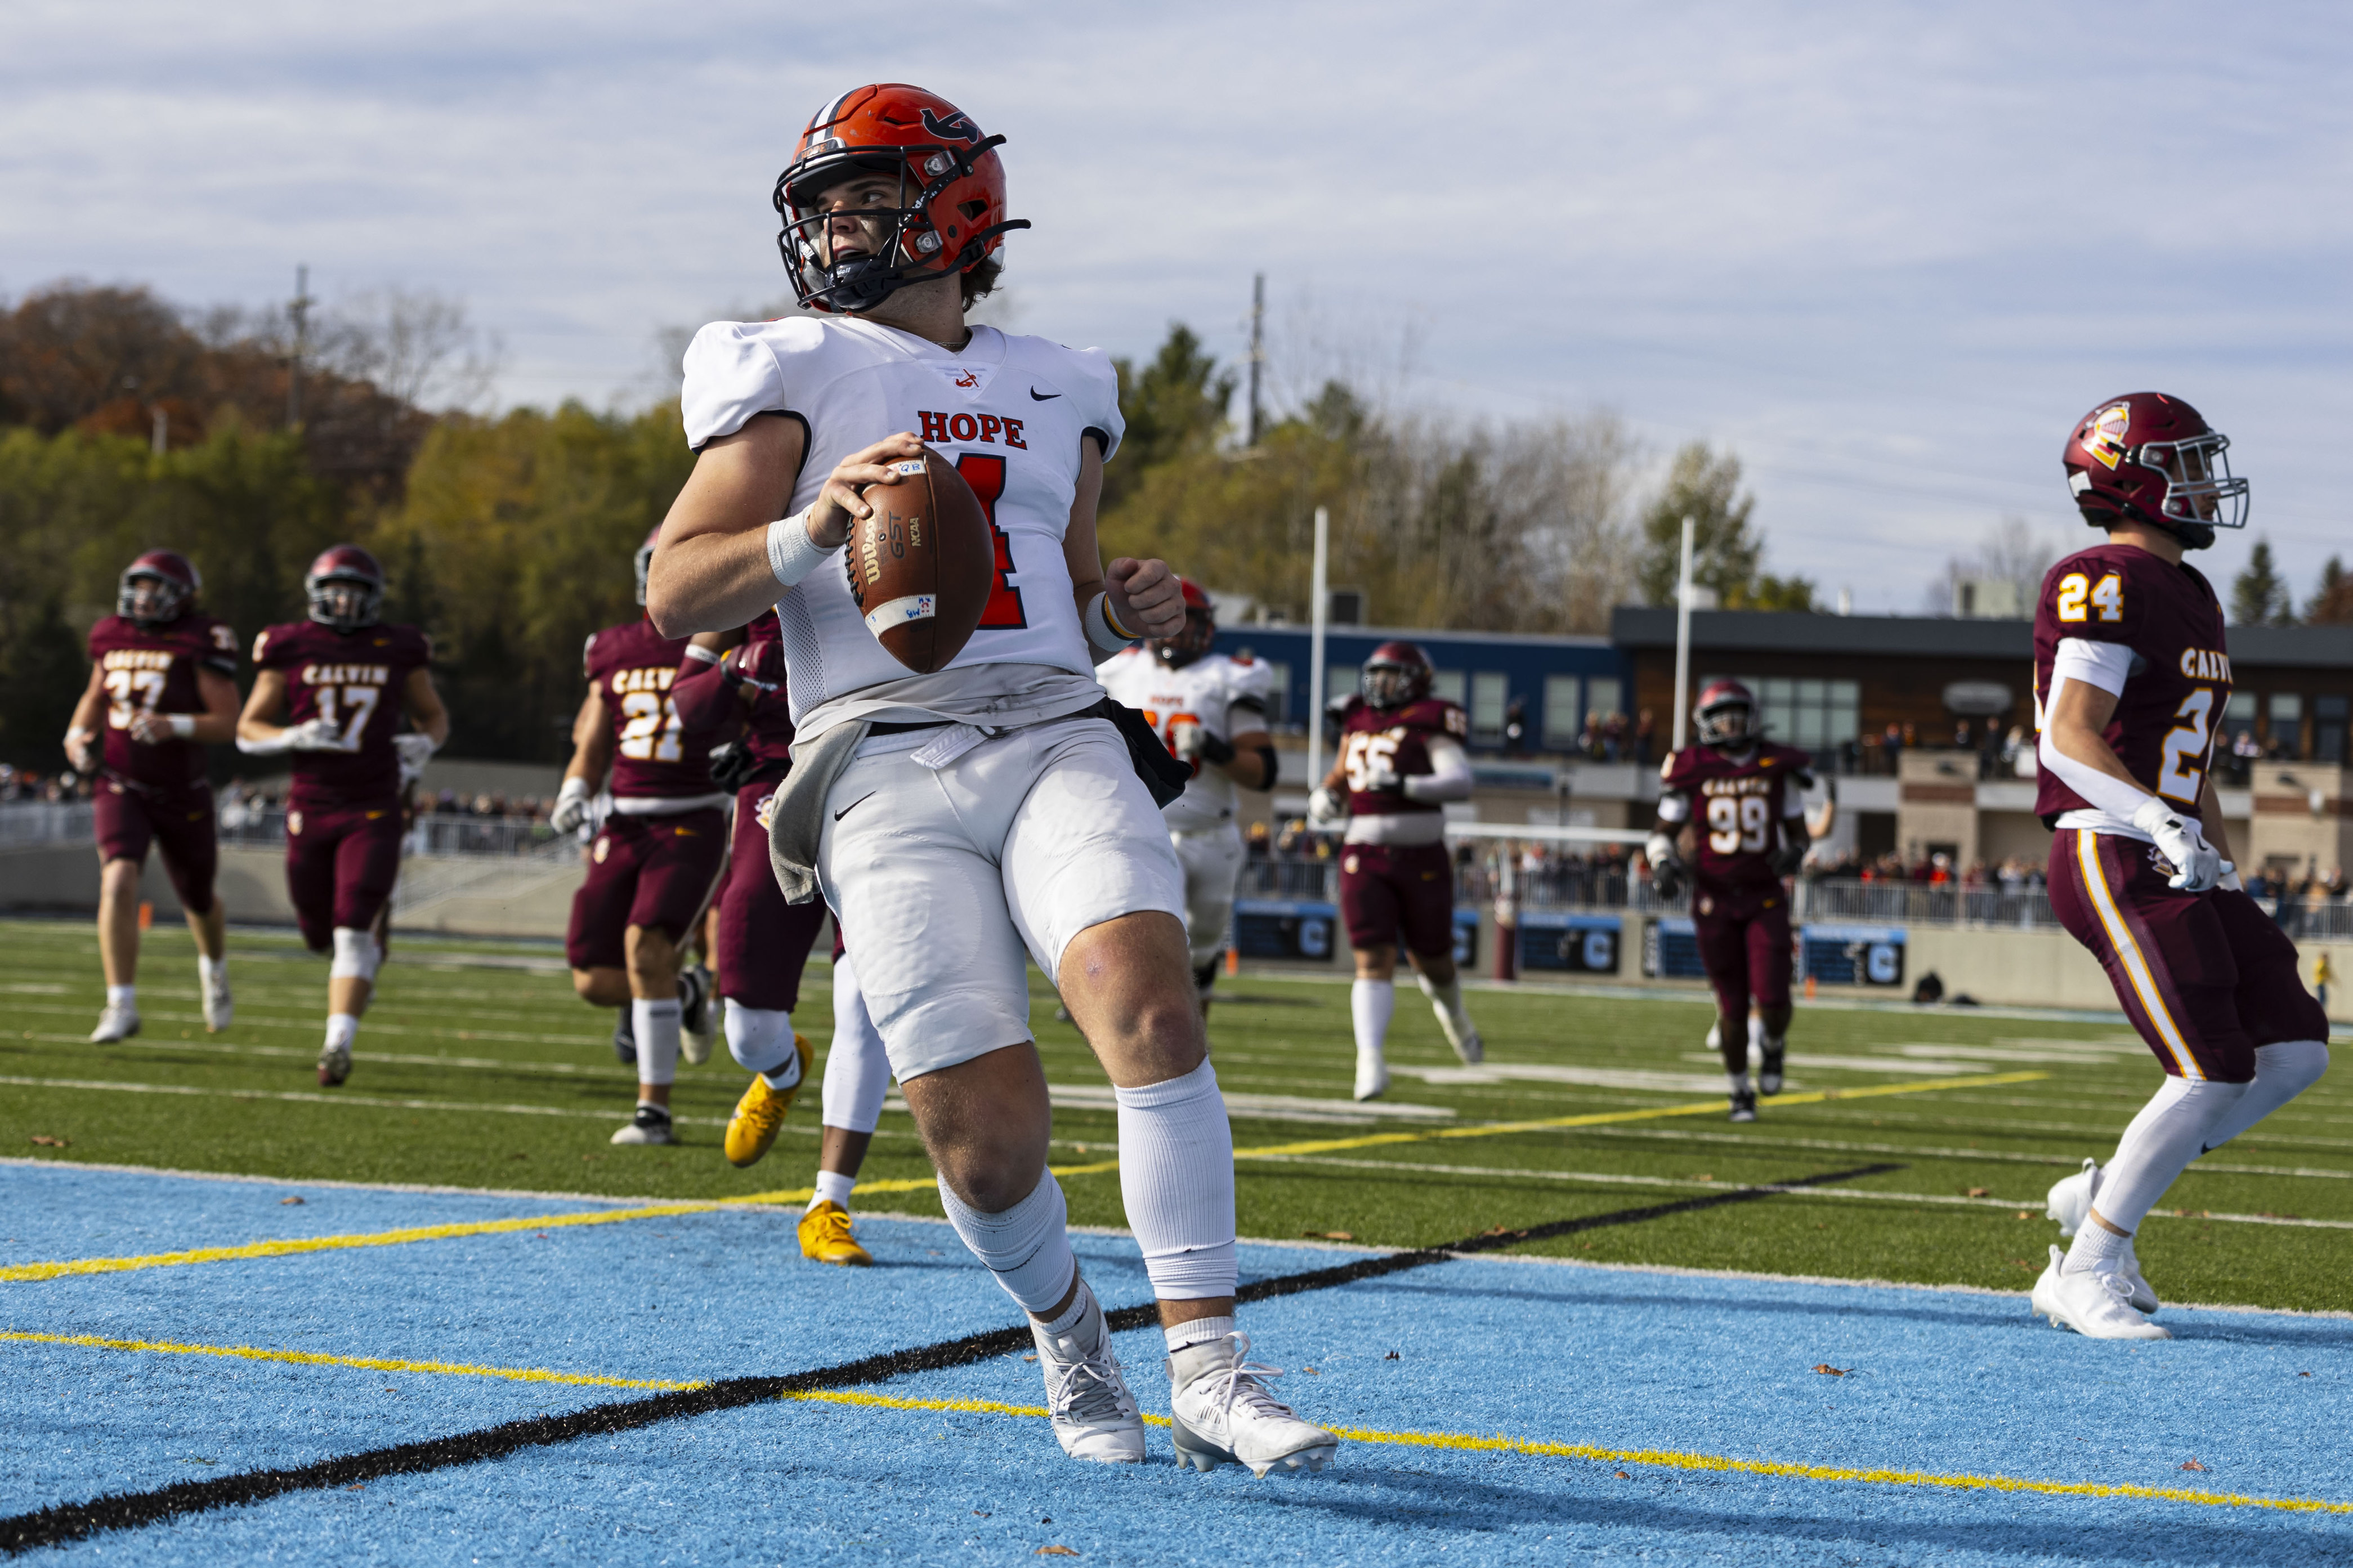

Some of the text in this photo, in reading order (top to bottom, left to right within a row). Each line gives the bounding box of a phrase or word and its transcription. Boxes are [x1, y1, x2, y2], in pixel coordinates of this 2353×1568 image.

[918, 411, 1028, 450] HOPE
[901, 463, 921, 472] QB
[889, 510, 905, 559] GST
[909, 517, 921, 547] NCAA
[2057, 572, 2124, 622] 24
[102, 669, 167, 730] 37
[302, 664, 390, 686] CALVIN
[315, 684, 381, 752] 17
[619, 691, 685, 763] 21
[2155, 687, 2233, 805] 2
[1706, 795, 1769, 855] 99
